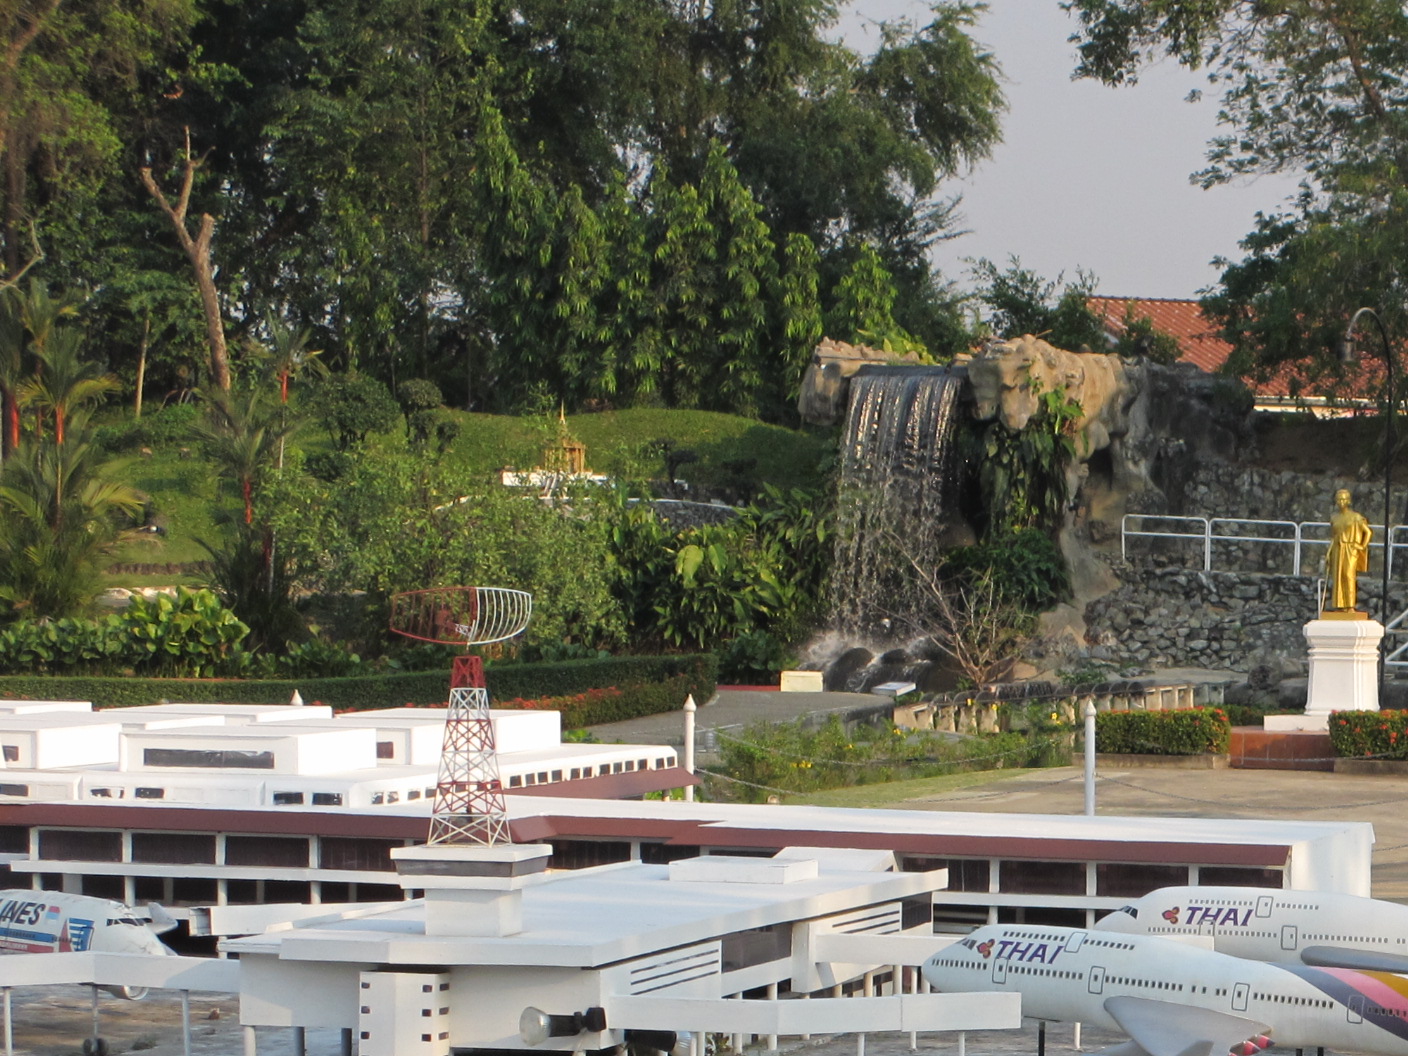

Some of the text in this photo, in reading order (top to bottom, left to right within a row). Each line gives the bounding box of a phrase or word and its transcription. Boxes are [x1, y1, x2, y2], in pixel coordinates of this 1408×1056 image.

[0, 899, 46, 926] INES
[1186, 906, 1254, 927] THAI
[998, 940, 1065, 965] THAI
